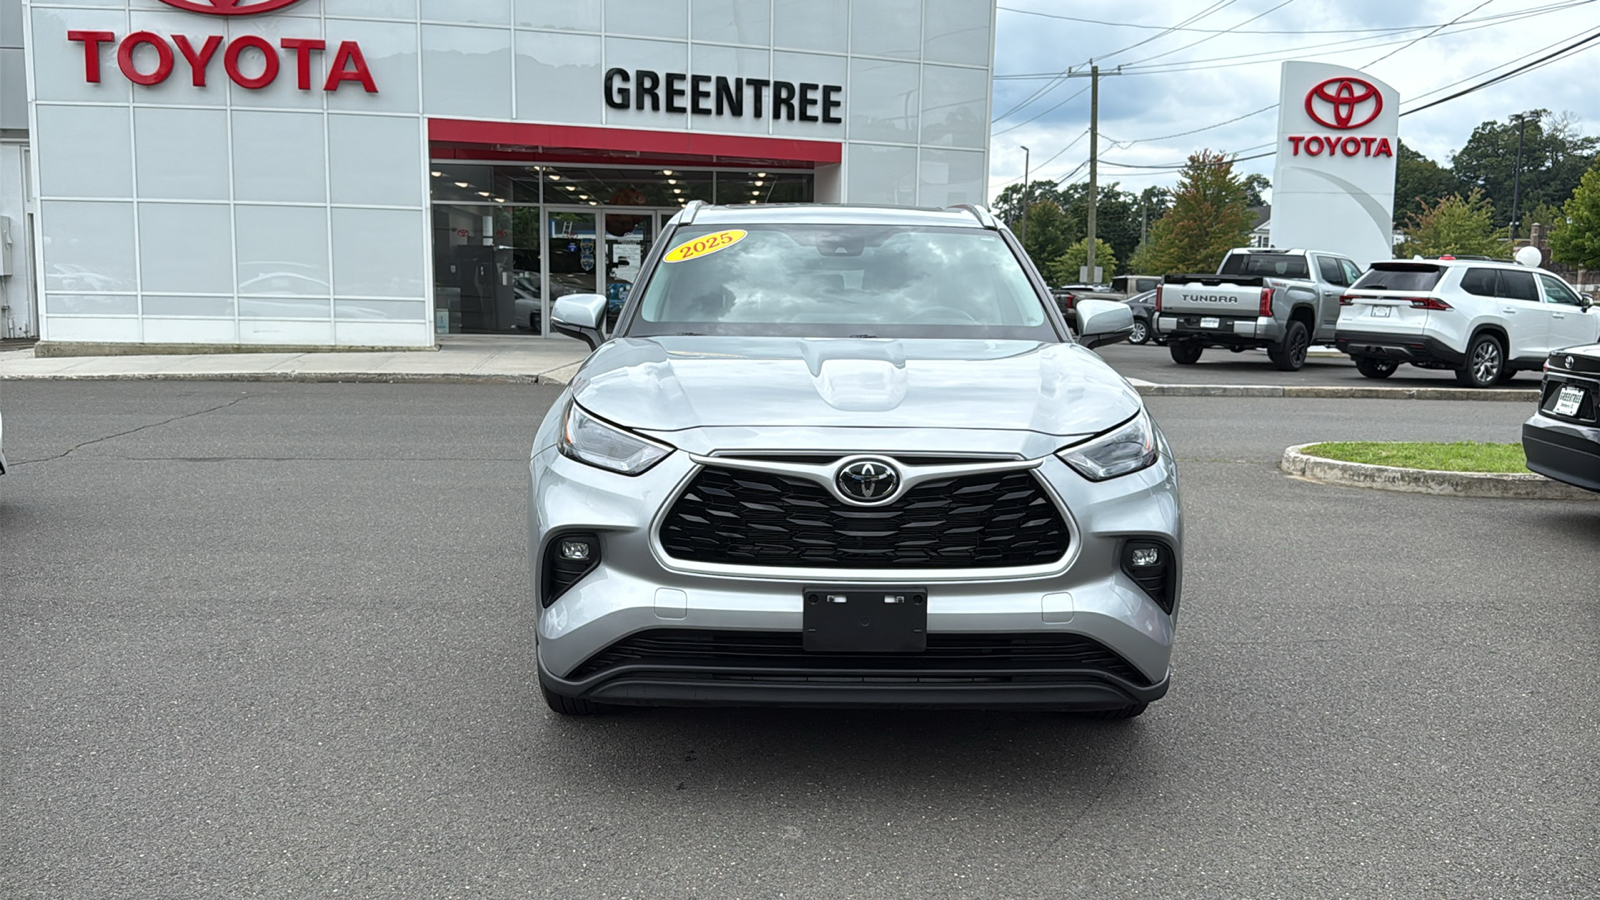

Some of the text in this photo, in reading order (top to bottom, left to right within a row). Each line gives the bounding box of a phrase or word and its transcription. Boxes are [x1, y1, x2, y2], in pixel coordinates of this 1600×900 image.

[67, 30, 379, 94] TOYOTA
[604, 67, 842, 124] GREENTREE
[1288, 135, 1393, 157] TOYOTA
[679, 232, 733, 259] 2025
[1182, 294, 1238, 303] TUNDRA
